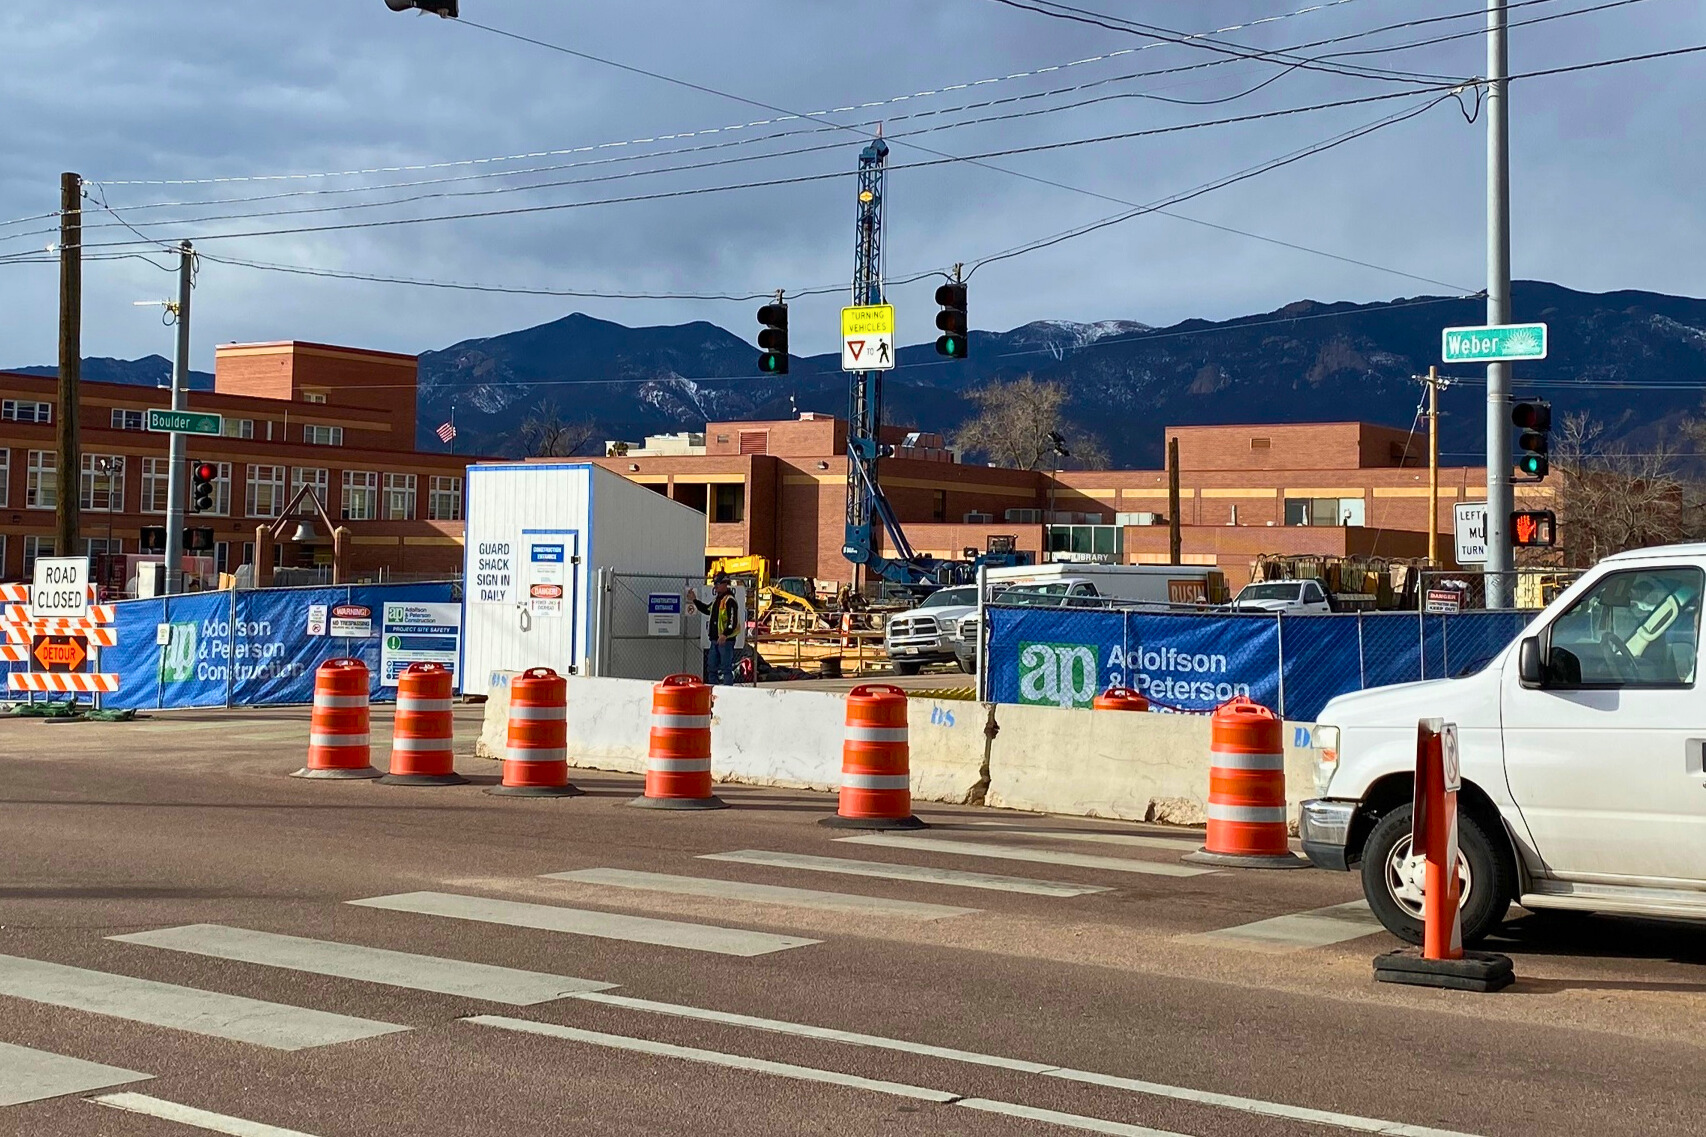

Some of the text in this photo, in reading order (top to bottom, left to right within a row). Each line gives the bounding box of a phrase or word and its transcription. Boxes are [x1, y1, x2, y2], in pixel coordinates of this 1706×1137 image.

[851, 311, 884, 320] TURNING
[849, 323, 886, 332] VEHICLES
[1448, 335, 1499, 354] Weber
[152, 414, 190, 428] Boulder
[1460, 511, 1480, 520] LEFT
[479, 543, 510, 555] GUARD
[1462, 546, 1484, 555] TURN
[478, 559, 509, 571] SHACK
[46, 567, 77, 583] ROAD
[477, 574, 510, 586] SIGN IN
[38, 591, 81, 608] CLOSED
[480, 590, 506, 601] DAILY
[1171, 585, 1205, 603] RUSIN
[1430, 592, 1456, 600] DANGER
[336, 608, 367, 616] WARNING!
[388, 606, 403, 622] ap
[43, 647, 75, 660] DETOUR
[199, 641, 209, 660] &
[1106, 645, 1227, 673] Adolfson
[1021, 645, 1097, 708] ap
[1134, 673, 1250, 700] Peterson
